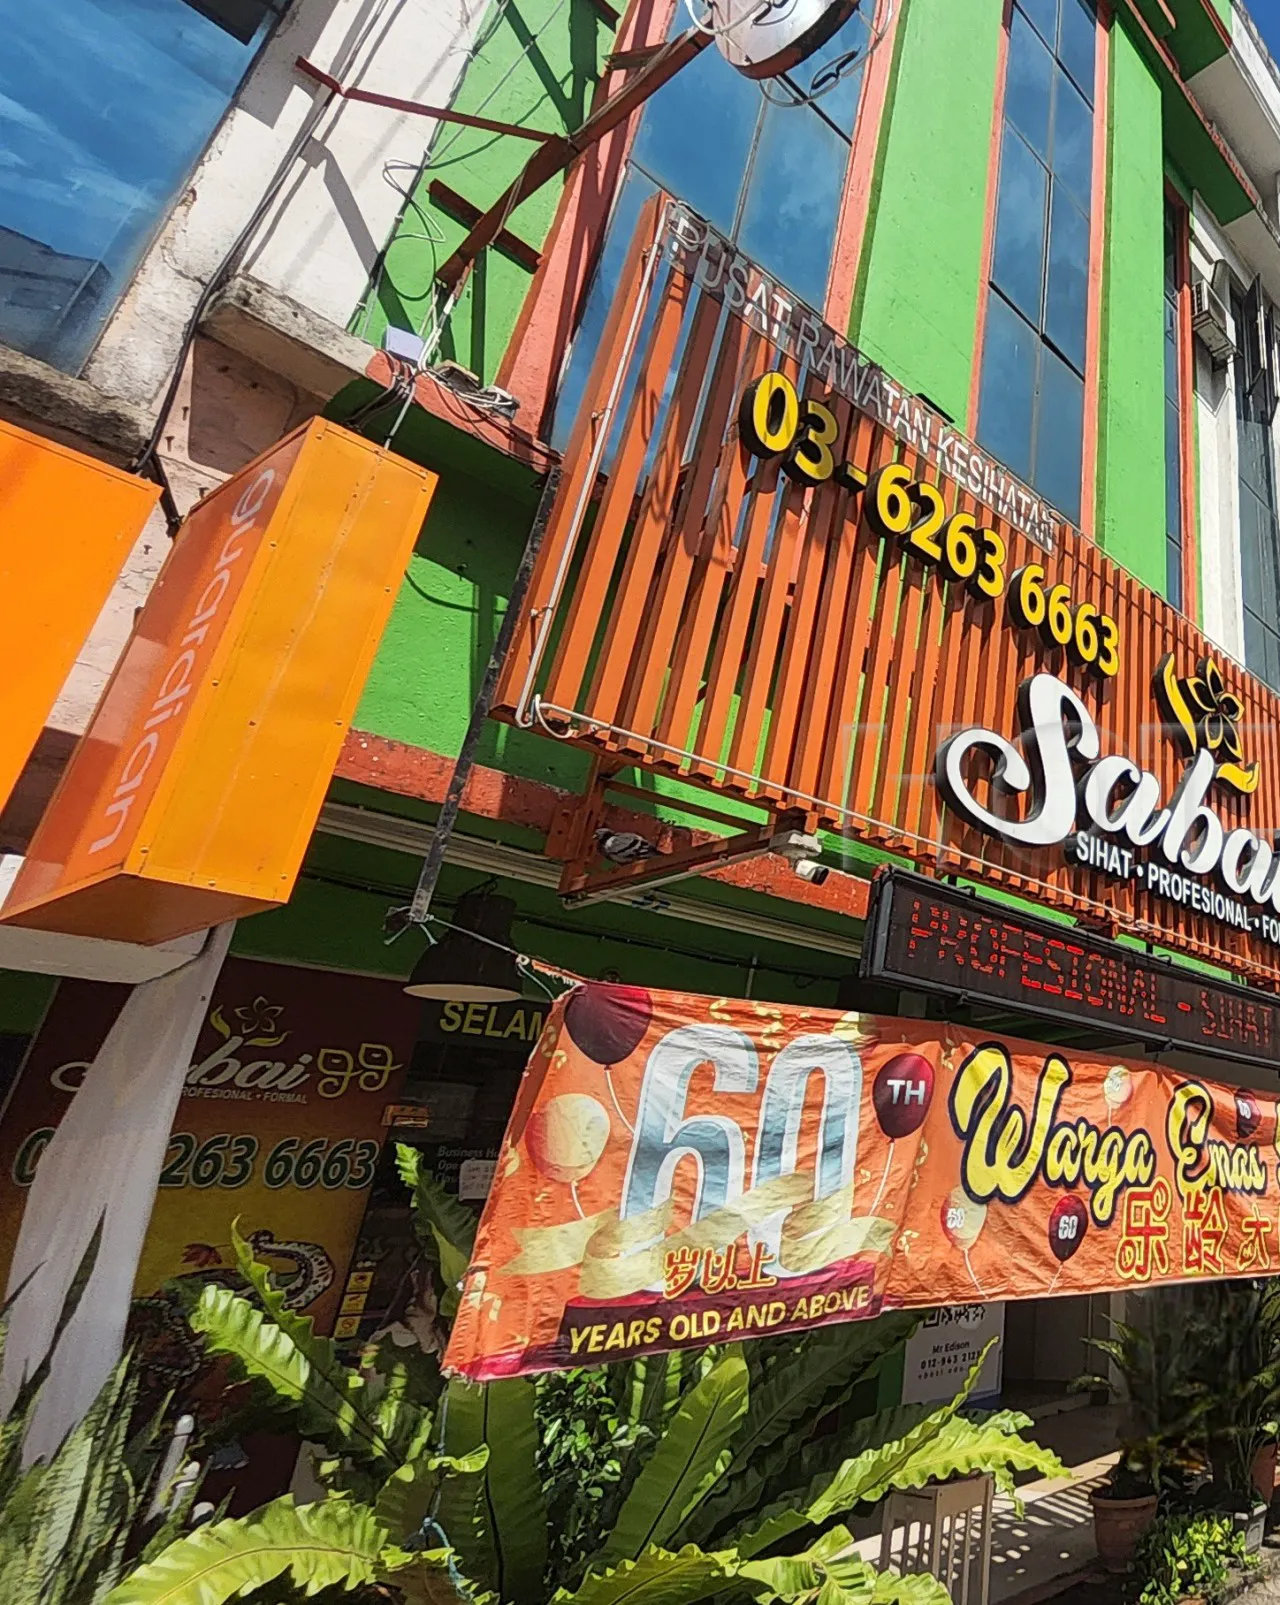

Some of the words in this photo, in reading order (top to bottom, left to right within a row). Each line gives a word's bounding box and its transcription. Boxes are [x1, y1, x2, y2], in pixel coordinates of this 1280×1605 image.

[670, 214, 793, 338] PUSAT
[796, 316, 932, 454] RAWATAN
[935, 432, 1055, 551] KESIHATAN
[743, 370, 1006, 599] 03-6263
[1012, 563, 1120, 678] 6663
[88, 467, 275, 855] guardian
[1075, 833, 1134, 881] SIHAT
[1147, 866, 1252, 930] PROFESIONAL
[1201, 990, 1272, 1047] SIHAT
[181, 1086, 253, 1101] ROFESIONAL
[262, 1091, 308, 1105] FORMAL
[951, 1041, 1158, 1227] Warga
[1167, 1080, 1267, 1199] Emas
[263, 1136, 380, 1190] 6663
[618, 1023, 863, 1289] 60
[886, 1078, 926, 1105] TH
[568, 1317, 661, 1356] YEARS
[667, 1308, 723, 1342] OLD
[727, 1300, 787, 1333] AND
[791, 1283, 870, 1321] ABOVE
[662, 1242, 778, 1300] 岁以上
